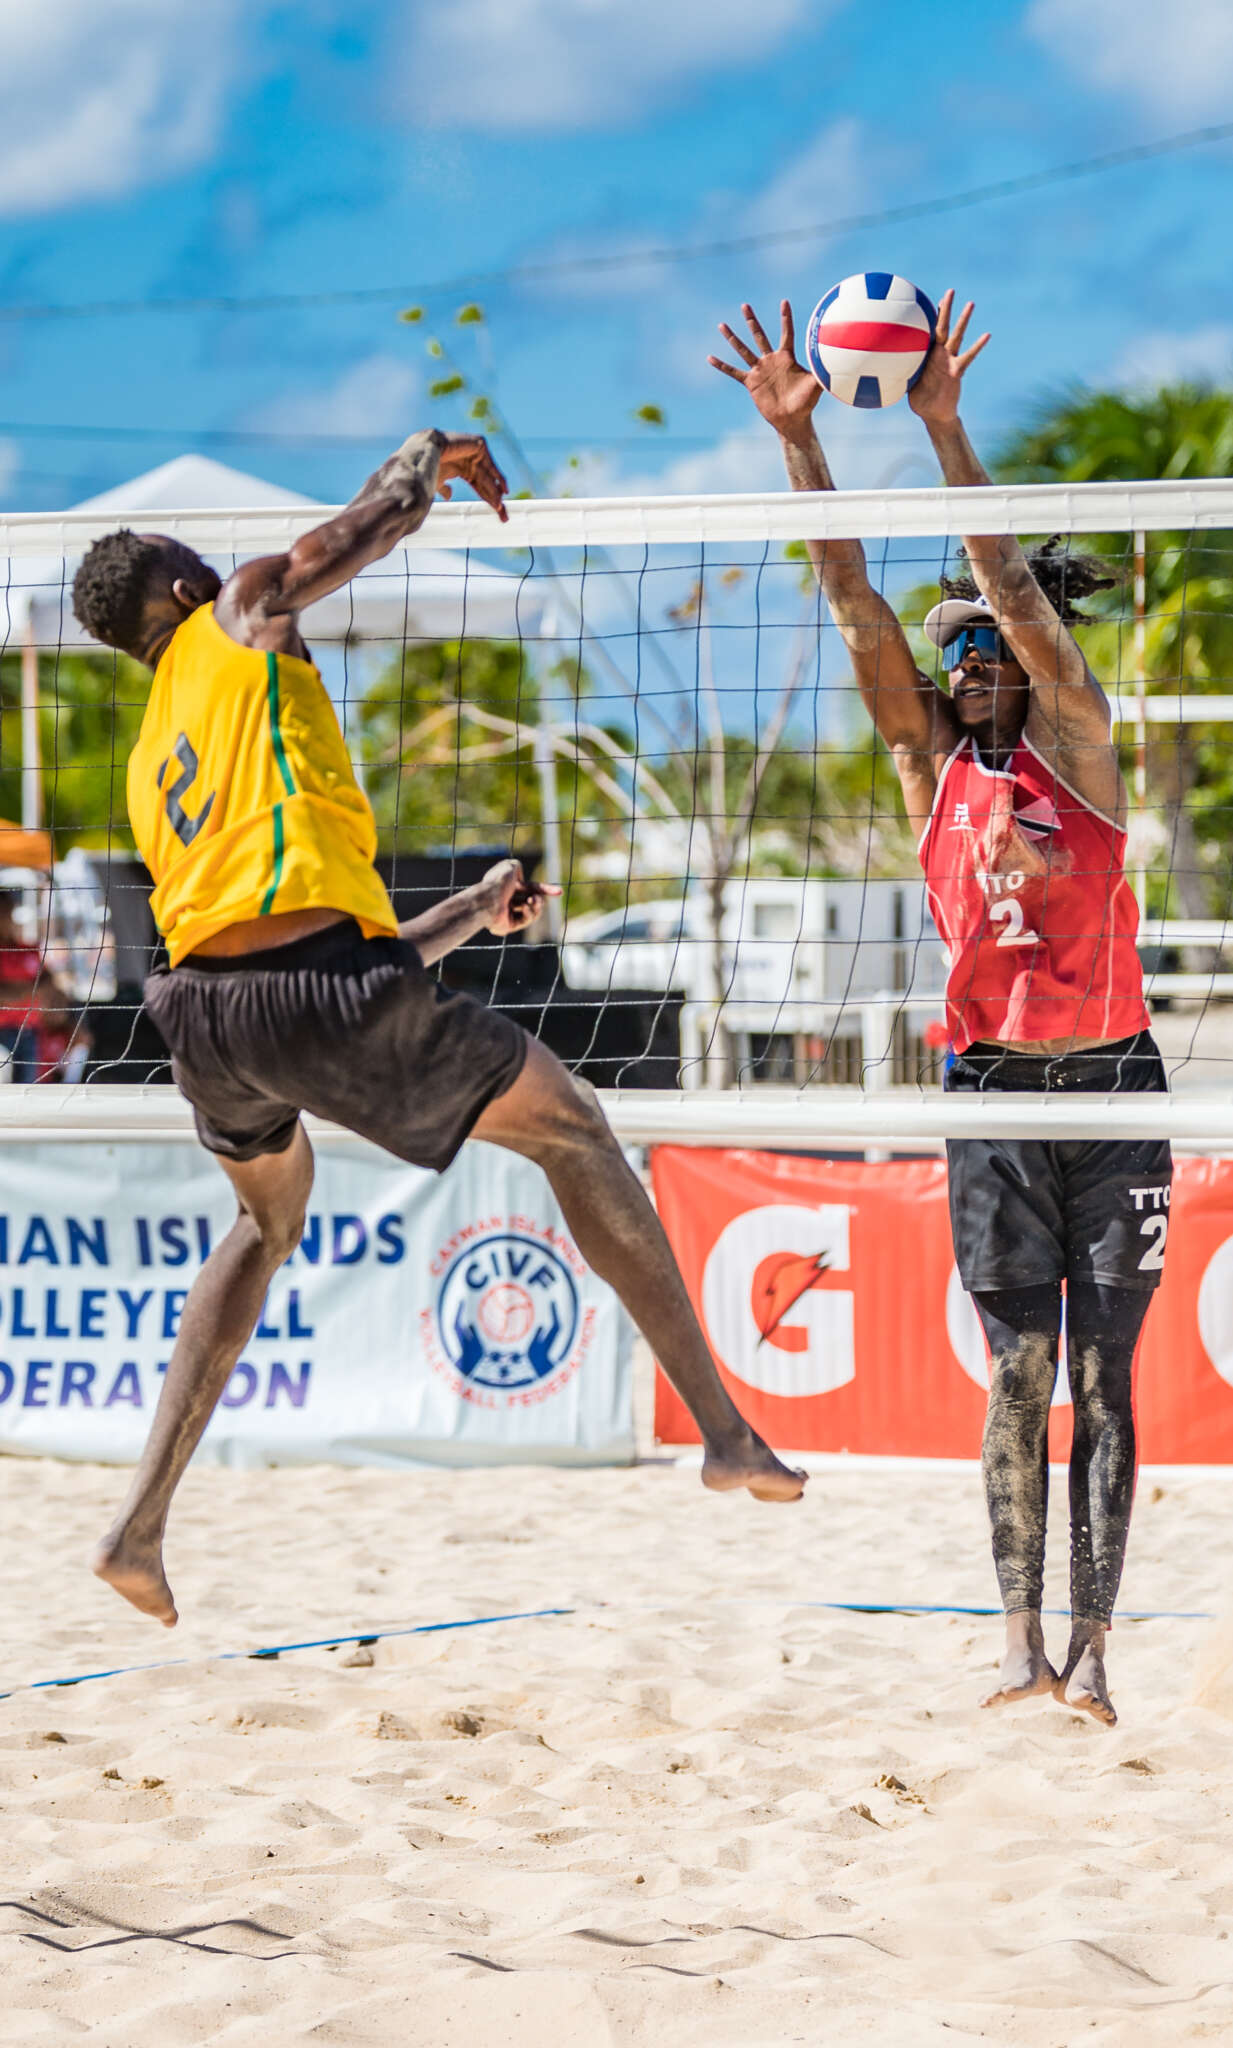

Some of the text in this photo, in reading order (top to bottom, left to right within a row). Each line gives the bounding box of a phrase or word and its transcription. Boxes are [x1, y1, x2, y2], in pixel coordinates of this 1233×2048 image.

[157, 732, 216, 848] 2
[989, 898, 1040, 947] 2
[0, 1213, 405, 1267] AN ISLNDS
[1137, 1214, 1169, 1271] 2
[465, 1248, 557, 1290] CIVF
[0, 1288, 314, 1339] LLEYBLL
[702, 1204, 856, 1398] G
